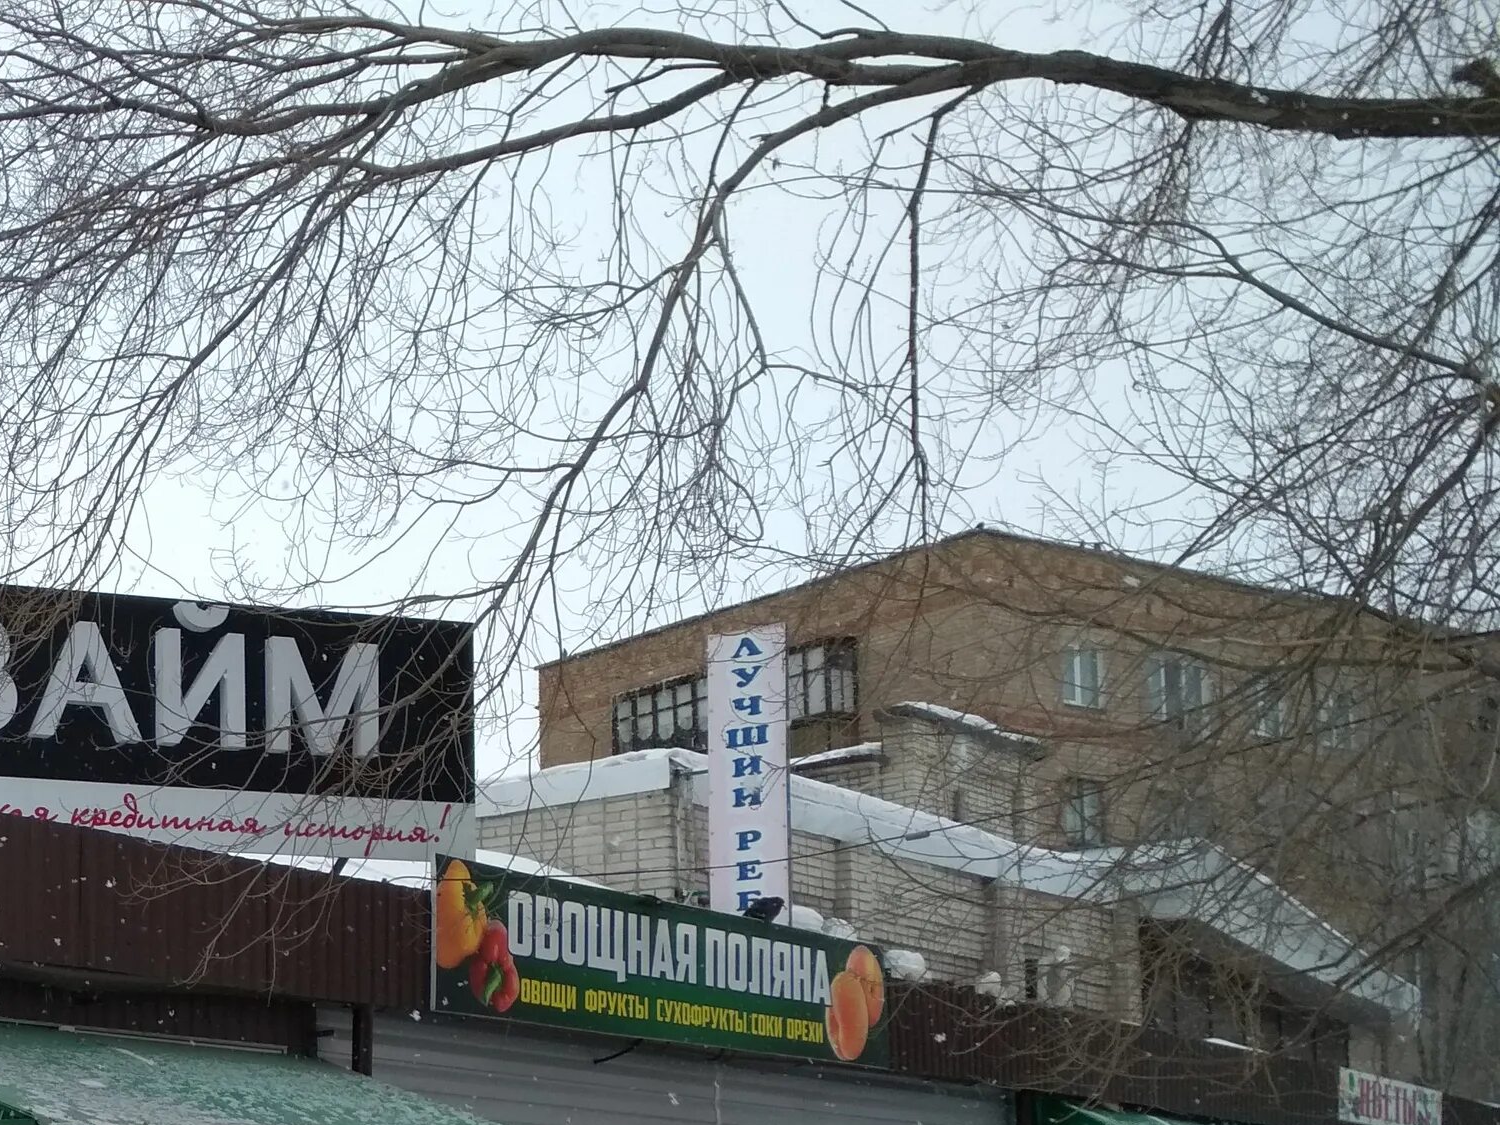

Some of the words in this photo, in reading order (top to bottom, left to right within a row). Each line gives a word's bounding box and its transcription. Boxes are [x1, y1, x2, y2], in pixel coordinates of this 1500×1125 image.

[70, 792, 268, 834] кредитная
[283, 803, 449, 857] история!
[508, 890, 698, 984] ОВОЩНАЯ
[705, 927, 832, 1006] ПОЛЯНА
[521, 977, 576, 1012] ОВОЩИ
[585, 988, 649, 1020] ФРУКТЫ
[656, 998, 747, 1034] СУХОФРУКТЫ
[752, 1012, 784, 1039] СОКИ
[786, 1018, 824, 1044] ОРЕХИ
